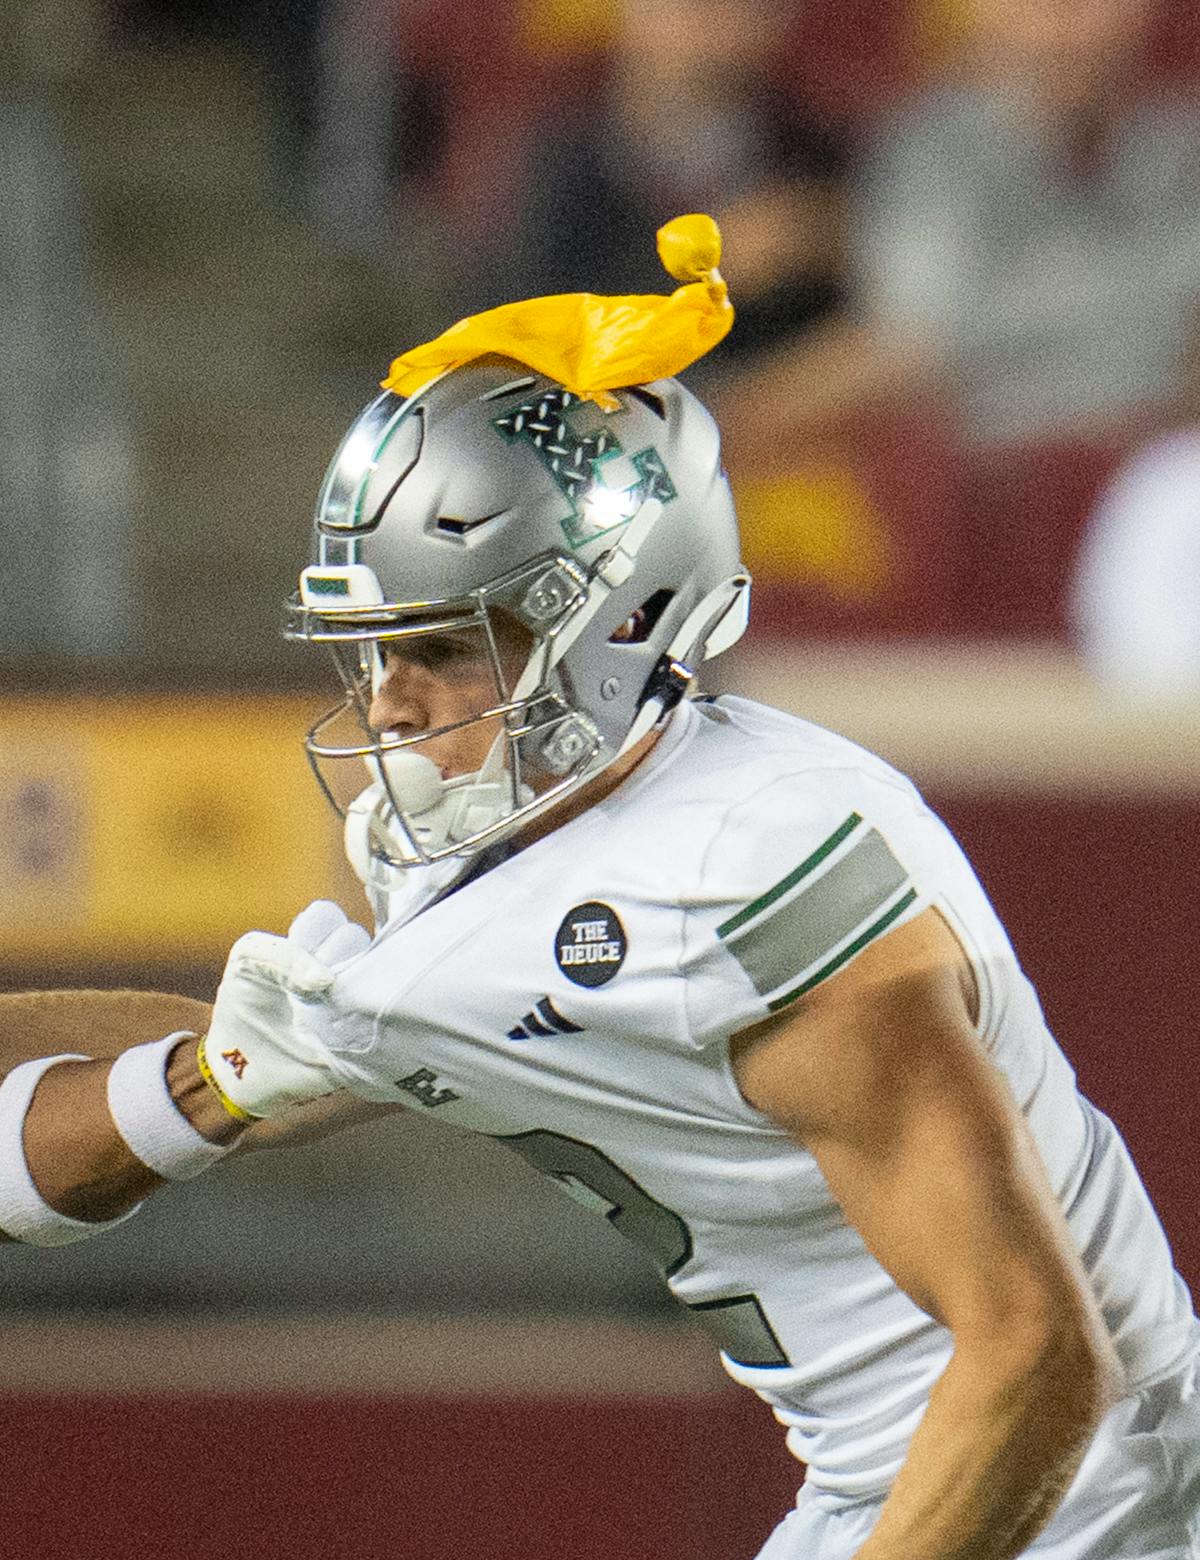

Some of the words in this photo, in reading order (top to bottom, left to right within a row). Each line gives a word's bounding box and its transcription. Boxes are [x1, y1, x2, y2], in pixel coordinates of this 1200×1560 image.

[572, 920, 609, 943] THE
[560, 940, 622, 966] DEUCE
[221, 1047, 249, 1080] M
